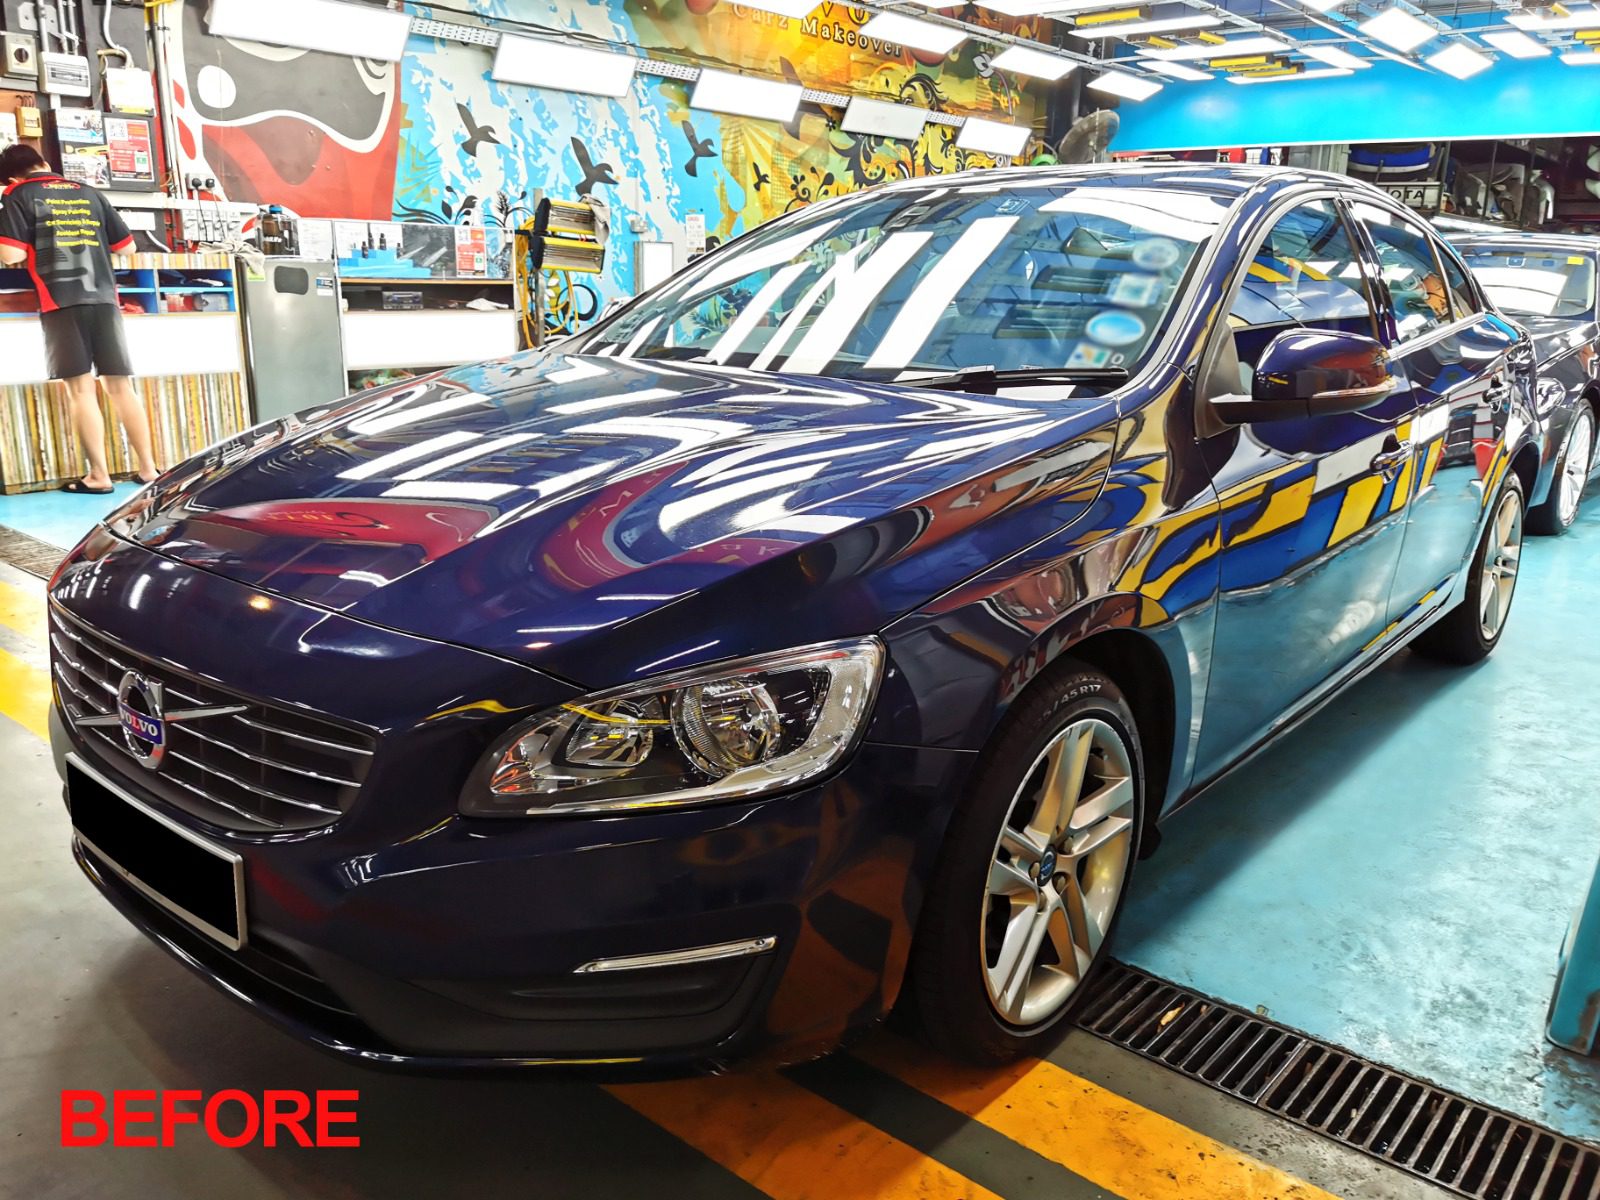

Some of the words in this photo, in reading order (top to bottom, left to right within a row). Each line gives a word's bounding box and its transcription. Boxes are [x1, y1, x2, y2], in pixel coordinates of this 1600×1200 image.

[732, 3, 789, 30] Carz
[800, 15, 903, 57] Makeover
[1390, 189, 1424, 200] OTA
[120, 709, 159, 738] VOLVO
